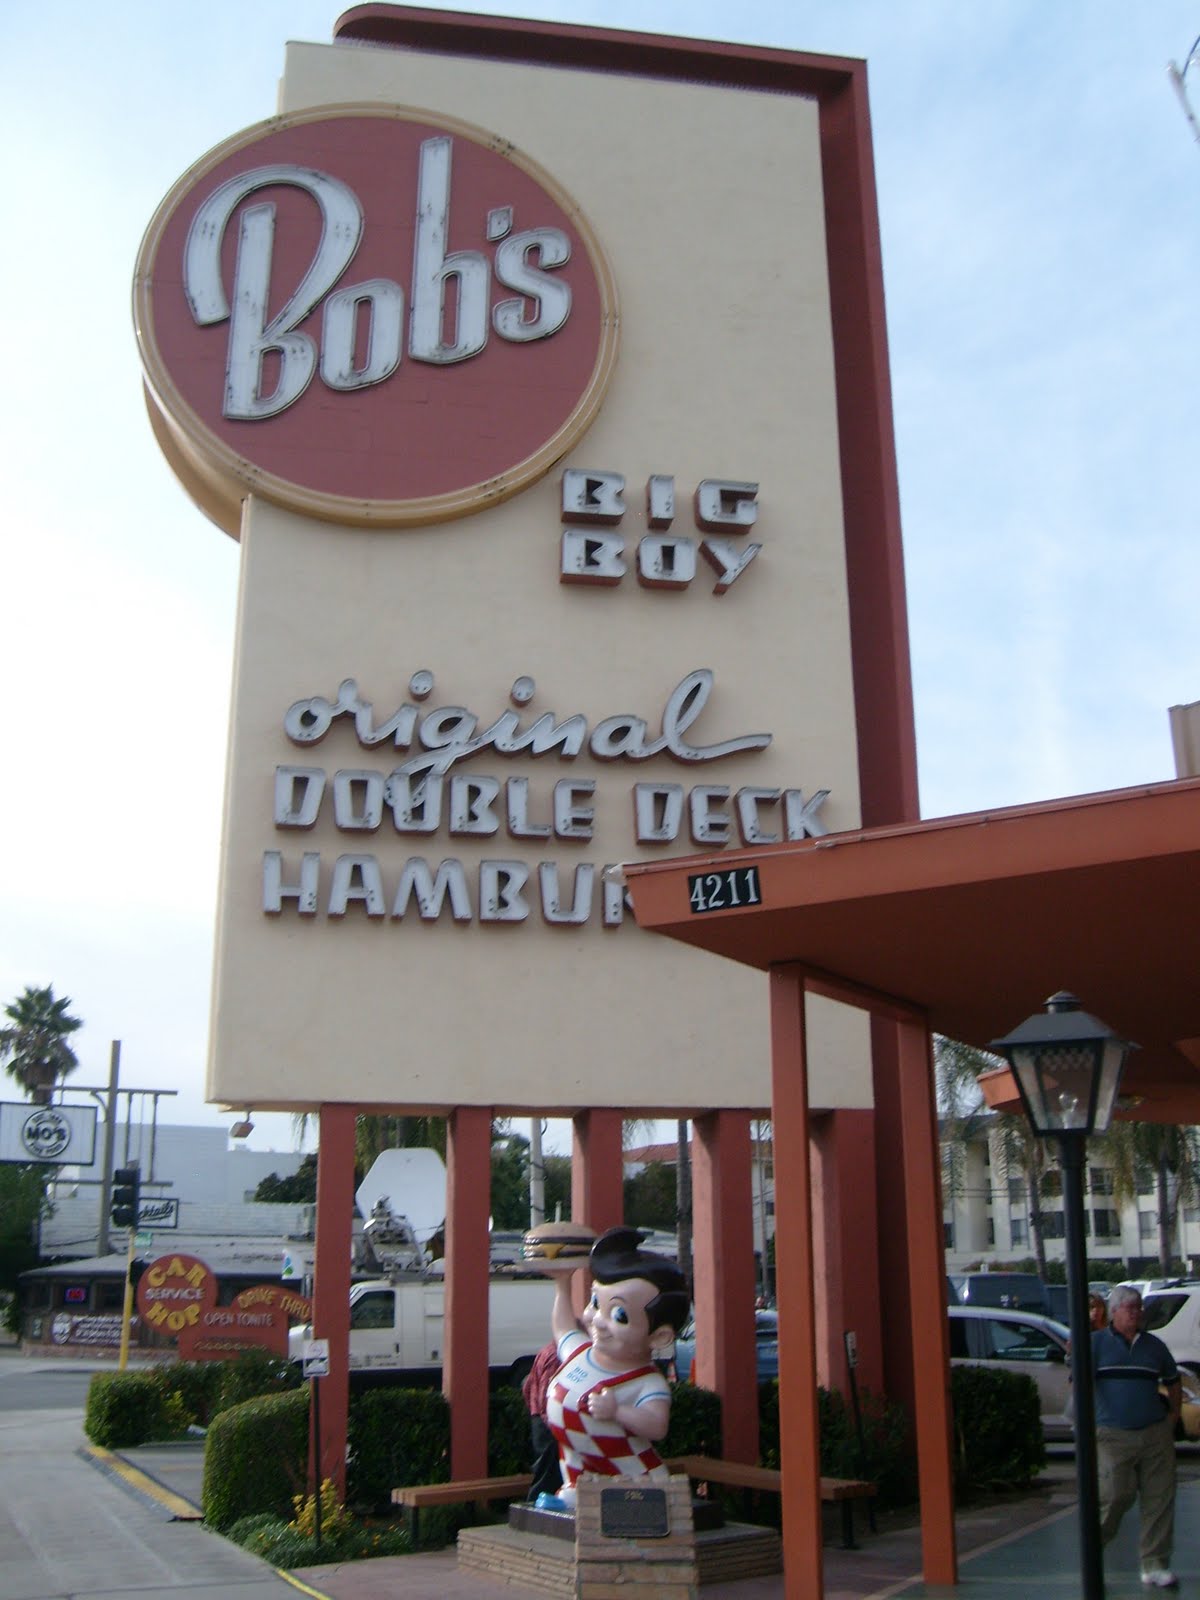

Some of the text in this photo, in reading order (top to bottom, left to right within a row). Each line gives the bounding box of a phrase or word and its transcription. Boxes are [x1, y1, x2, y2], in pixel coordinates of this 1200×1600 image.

[182, 136, 573, 421] Bob's
[562, 468, 760, 534] BIG
[560, 529, 763, 595] BOY
[284, 668, 772, 808] original
[274, 765, 831, 846] DOUBLE DECK
[690, 868, 760, 911] 4211
[145, 1287, 204, 1300] SERVICE
[147, 1257, 207, 1288] CAR
[146, 1301, 200, 1331] HOP
[203, 1312, 234, 1327] OPEN
[279, 1295, 313, 1317] THRU
